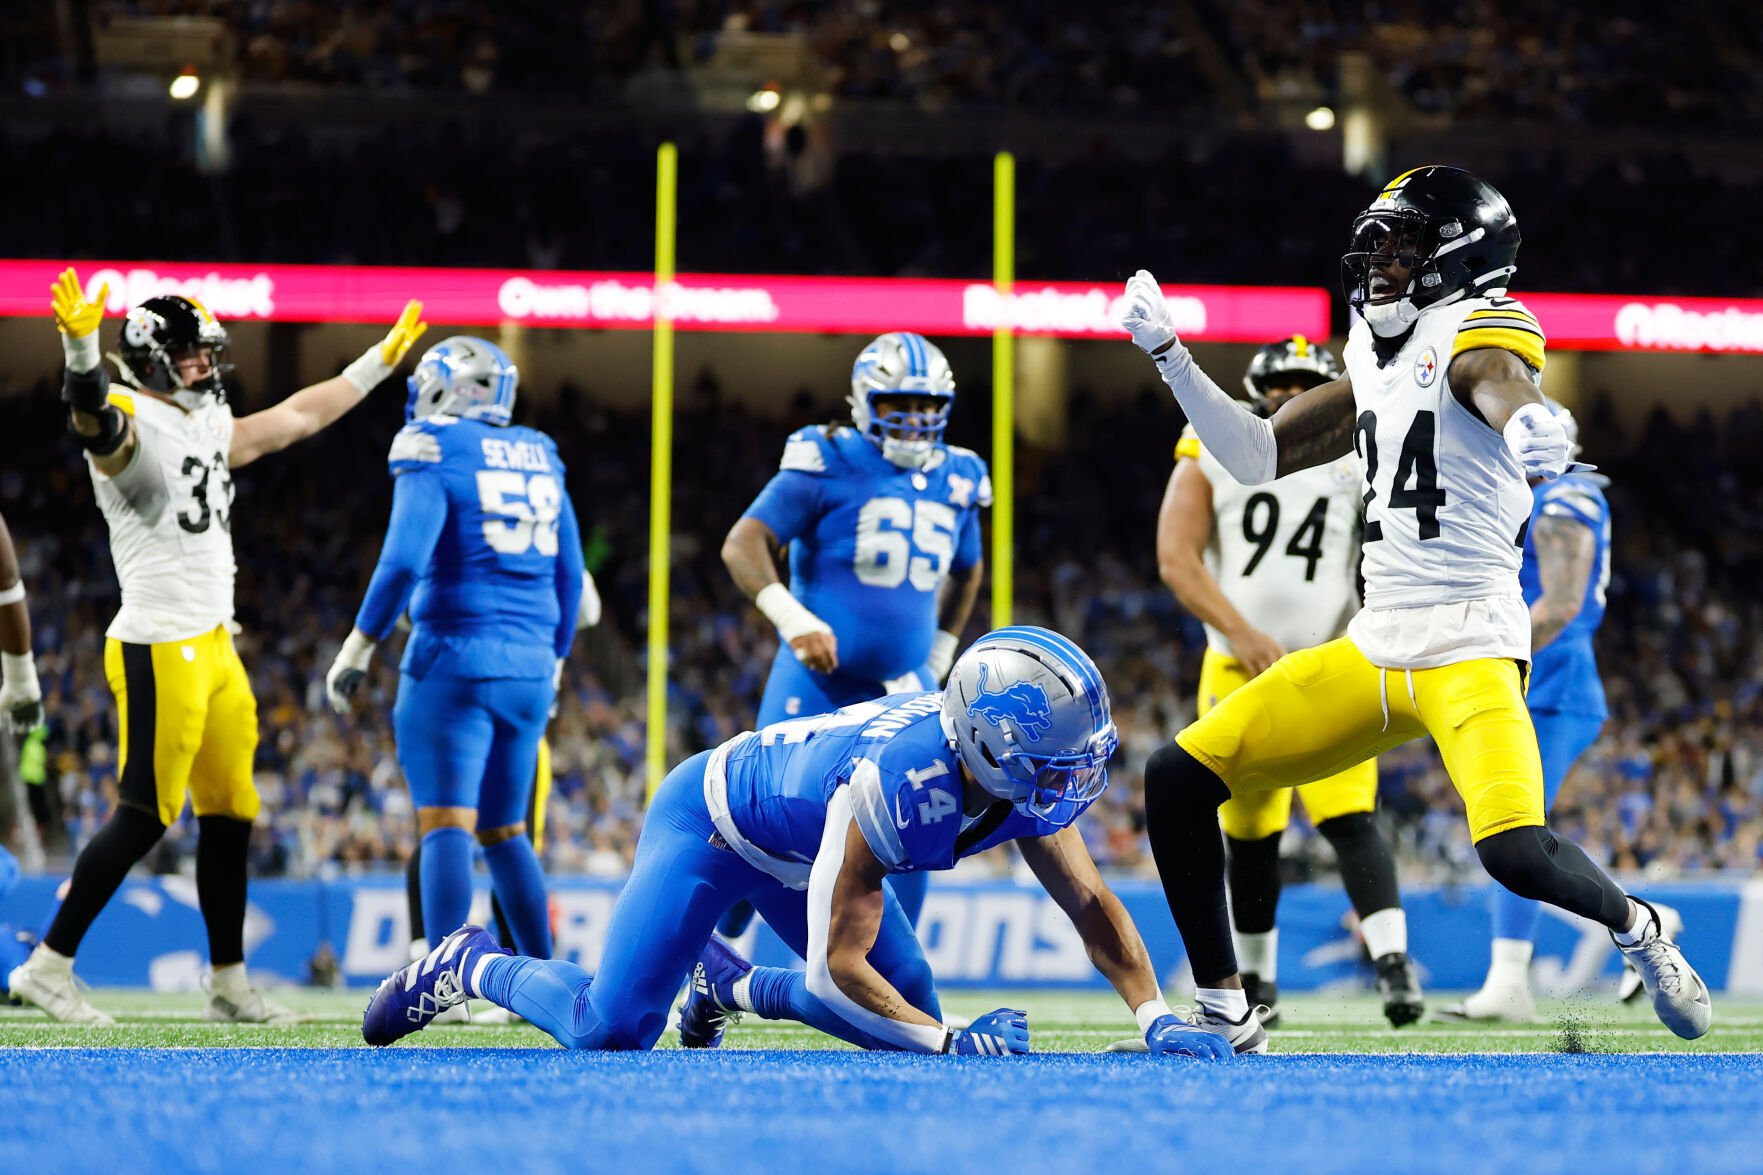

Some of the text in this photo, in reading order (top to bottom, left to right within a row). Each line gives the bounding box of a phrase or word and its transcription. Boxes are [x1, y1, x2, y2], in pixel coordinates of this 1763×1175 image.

[481, 437, 551, 473] SEWELL
[1354, 410, 1446, 541] 24
[475, 469, 561, 556] 58
[854, 496, 956, 592] 65
[1242, 492, 1329, 582] 94
[904, 758, 958, 827] 14
